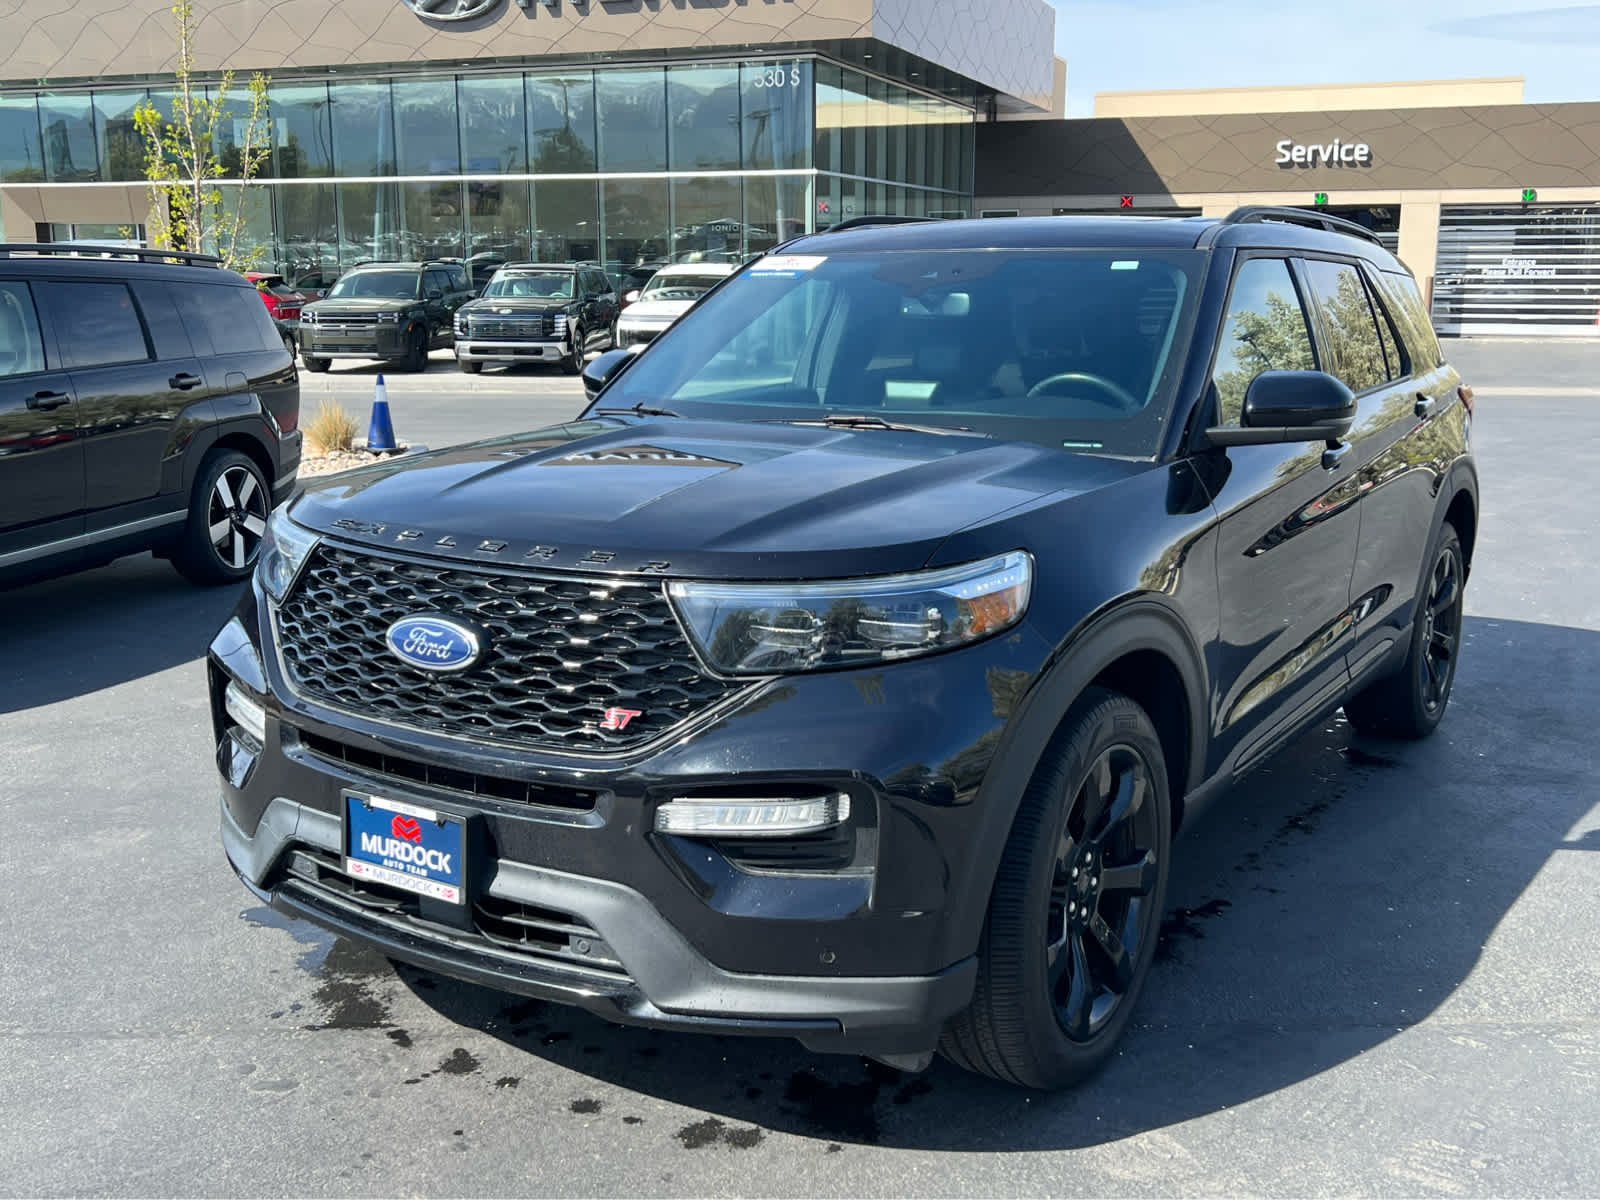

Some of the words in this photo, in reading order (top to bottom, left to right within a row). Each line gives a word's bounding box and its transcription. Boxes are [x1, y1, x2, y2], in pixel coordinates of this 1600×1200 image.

[754, 69, 785, 88] 530
[790, 68, 801, 87] S
[1275, 138, 1370, 164] Service
[1502, 257, 1537, 266] Entrance
[1525, 266, 1557, 277] Forward
[330, 518, 672, 573] EXPLORER
[403, 627, 454, 660] Ford
[600, 707, 643, 730] ST
[361, 831, 452, 875] MURDOCK
[383, 858, 405, 871] AUTO
[406, 864, 429, 877] TEAM
[372, 869, 434, 894] MURDOCK
